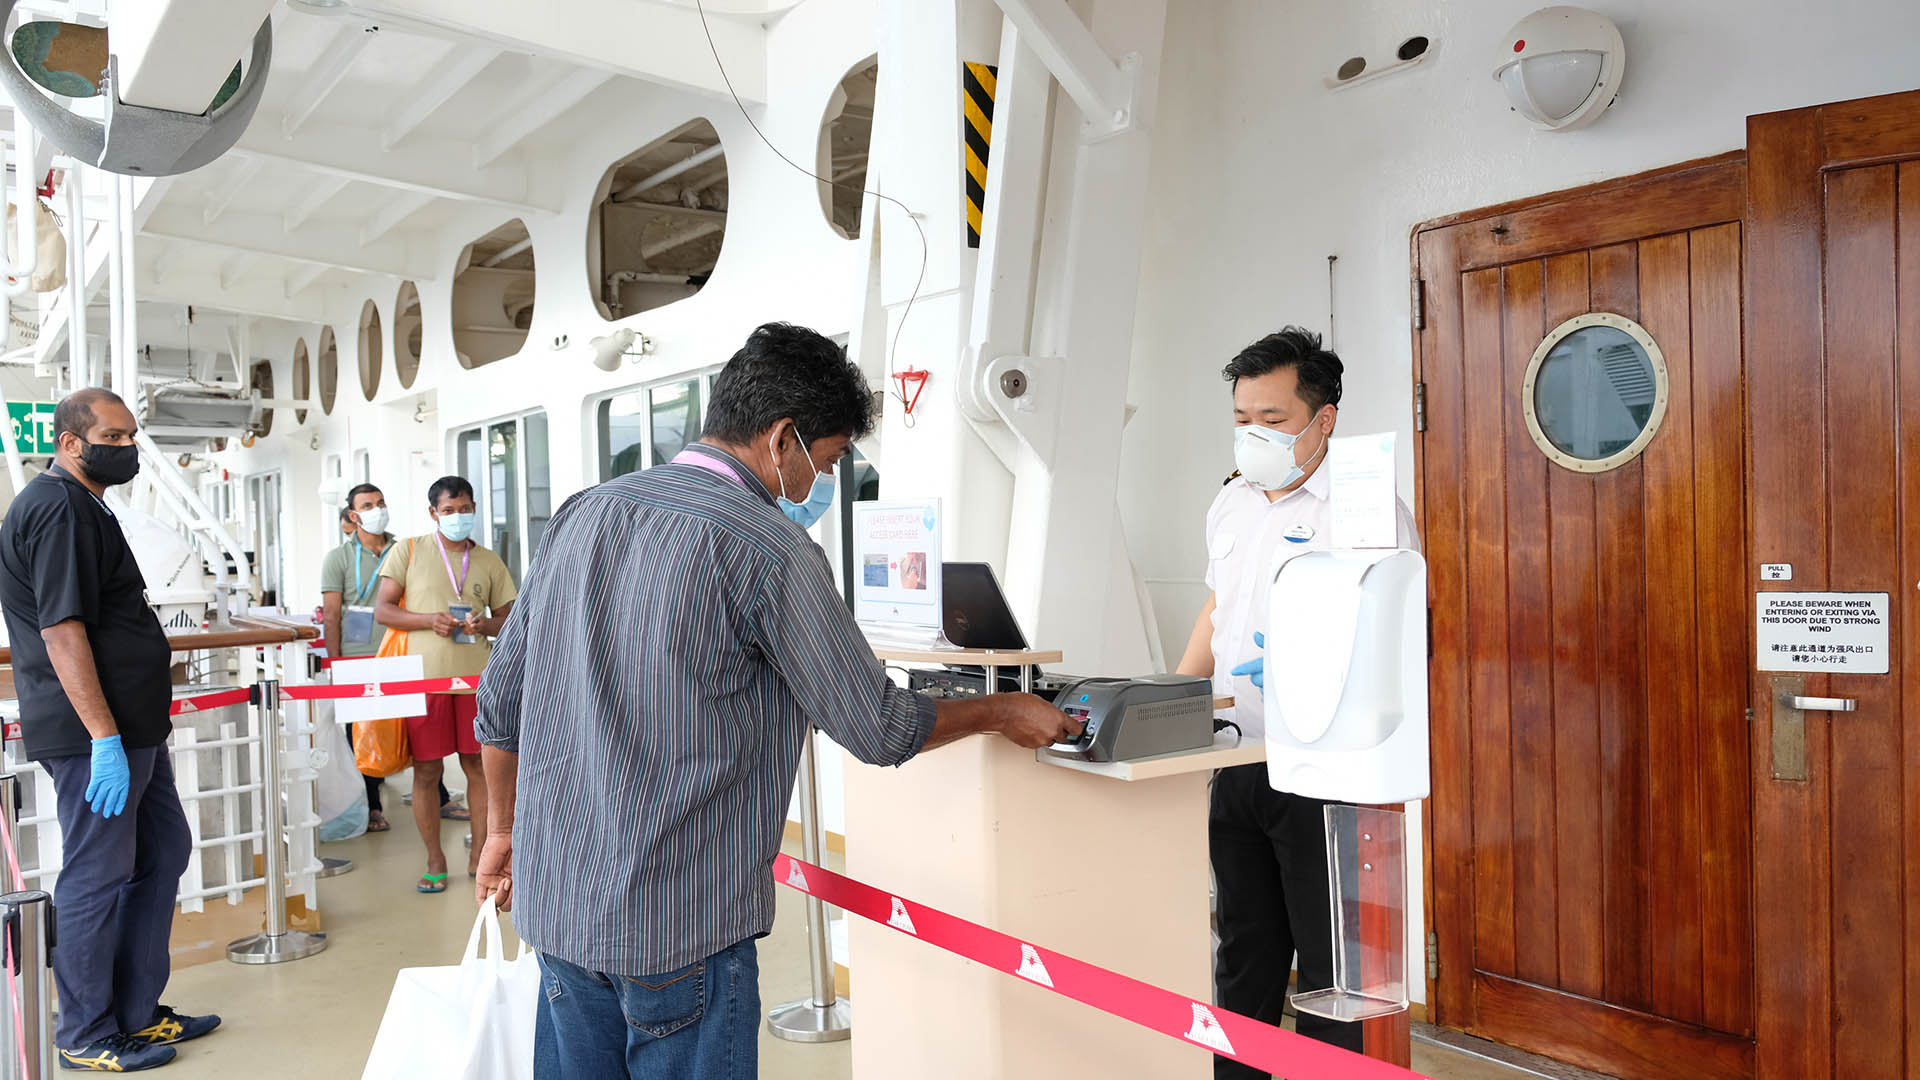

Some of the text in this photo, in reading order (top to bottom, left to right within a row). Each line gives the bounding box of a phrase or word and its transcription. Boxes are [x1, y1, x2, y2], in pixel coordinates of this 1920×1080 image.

[1792, 655, 1847, 663] 请您小心行走
